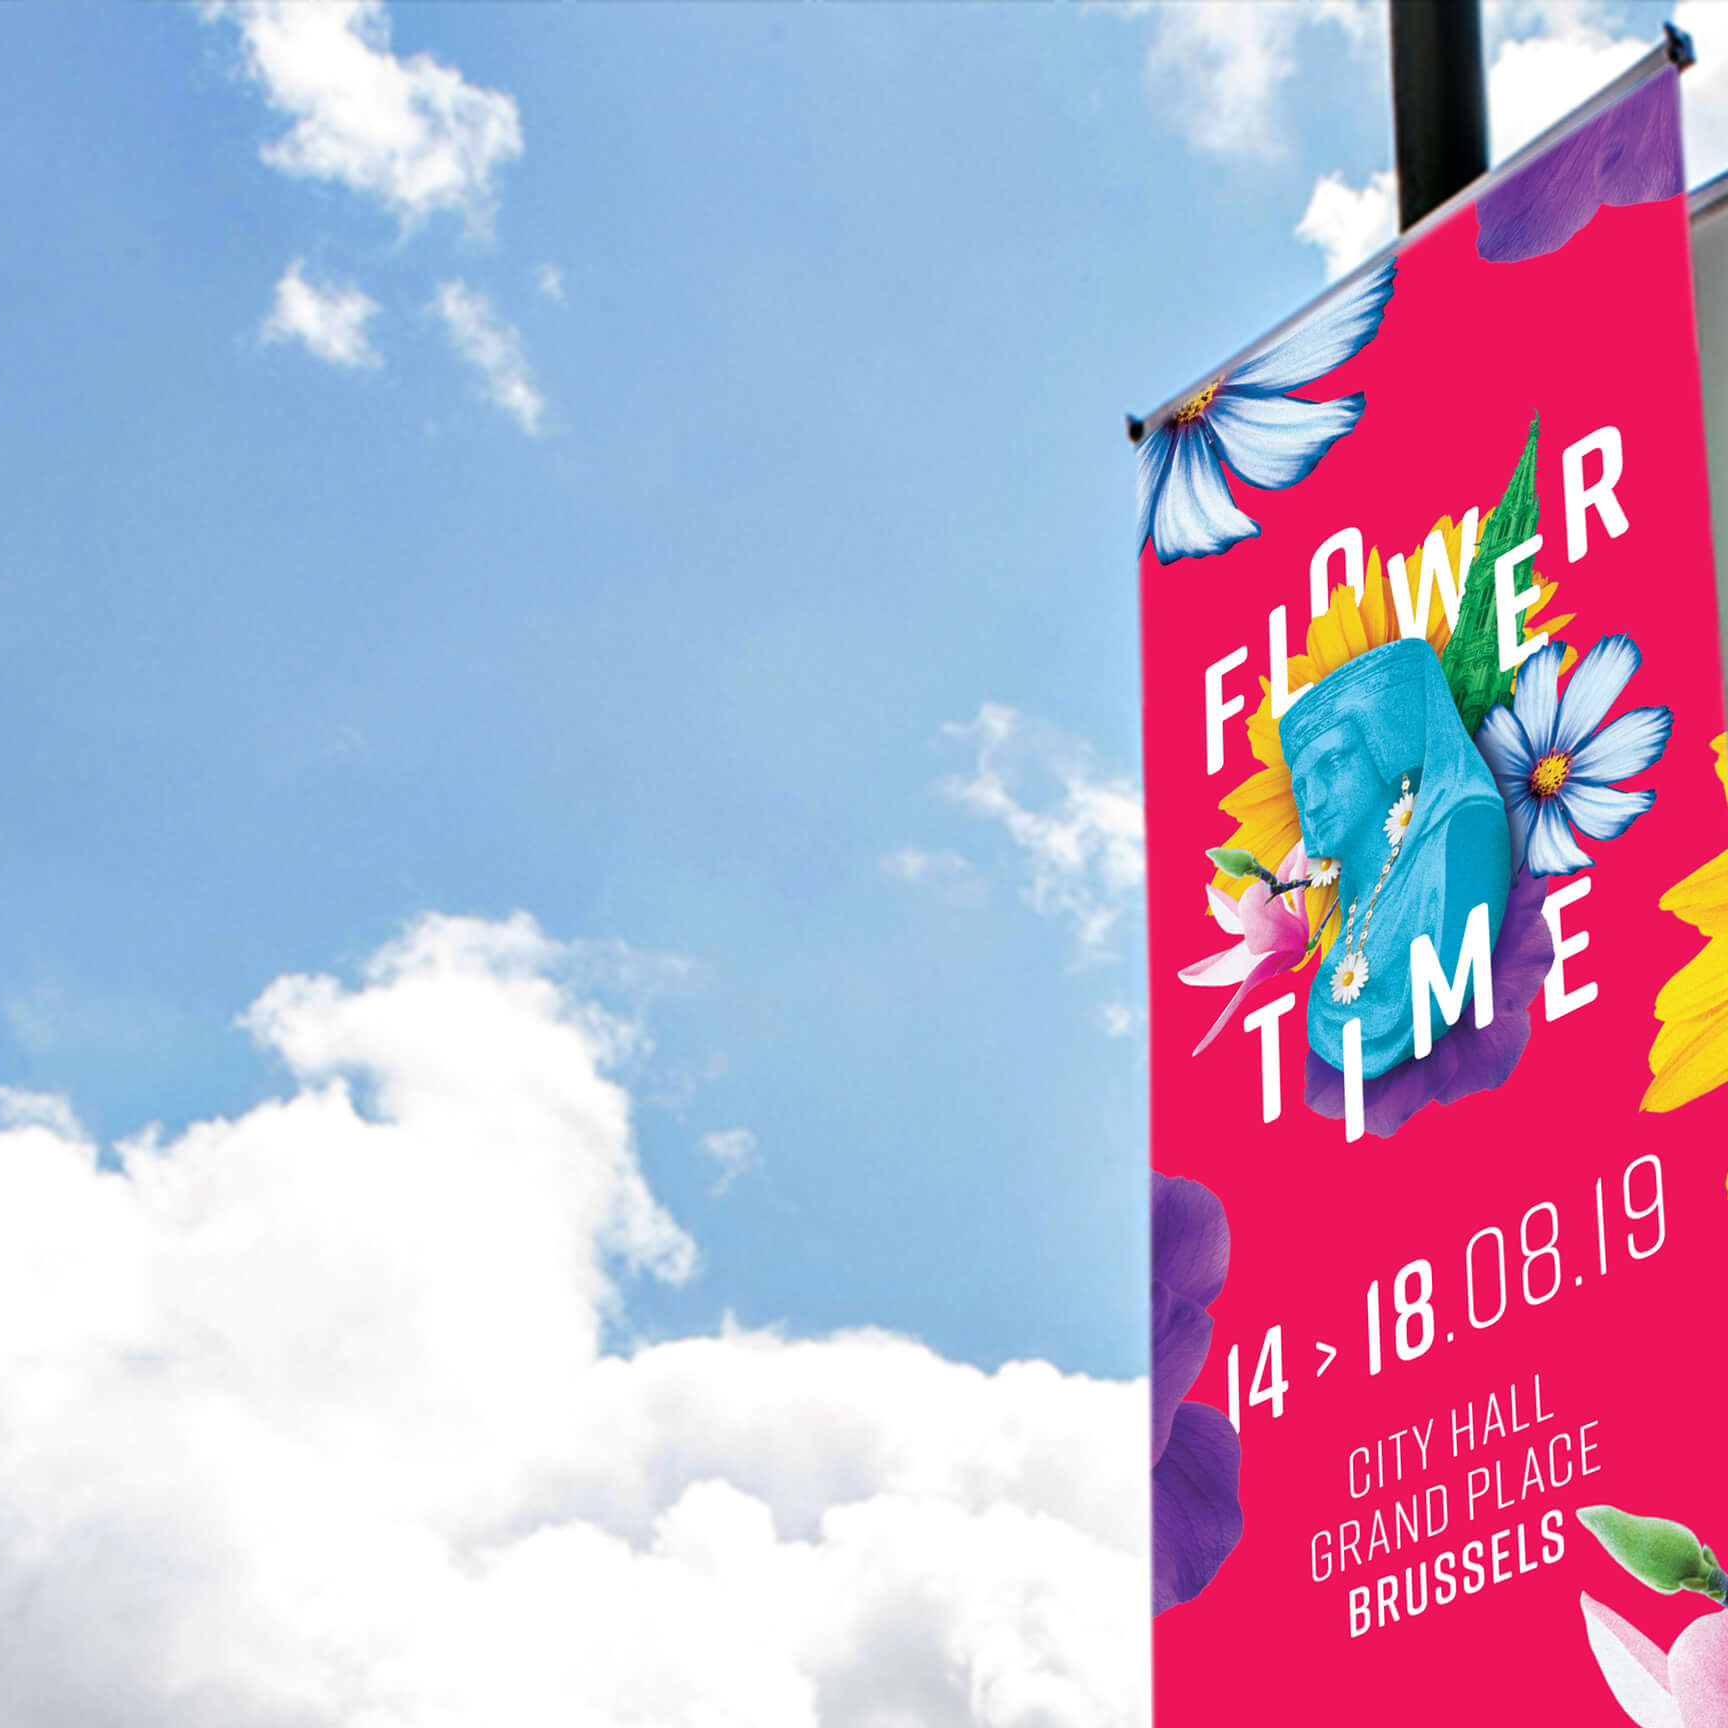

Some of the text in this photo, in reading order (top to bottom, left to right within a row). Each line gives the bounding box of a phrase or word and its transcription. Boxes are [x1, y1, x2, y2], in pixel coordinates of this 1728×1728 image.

[1204, 425, 1630, 776] FLOWER
[1243, 876, 1600, 1143] TIME
[1227, 1325, 1289, 1435] 14
[1366, 1154, 1666, 1376] 18.08.19
[1310, 1420, 1602, 1582] GRAND PLACE
[1348, 1373, 1555, 1499] CITY HALL
[1348, 1509, 1566, 1638] BRUSSELS
